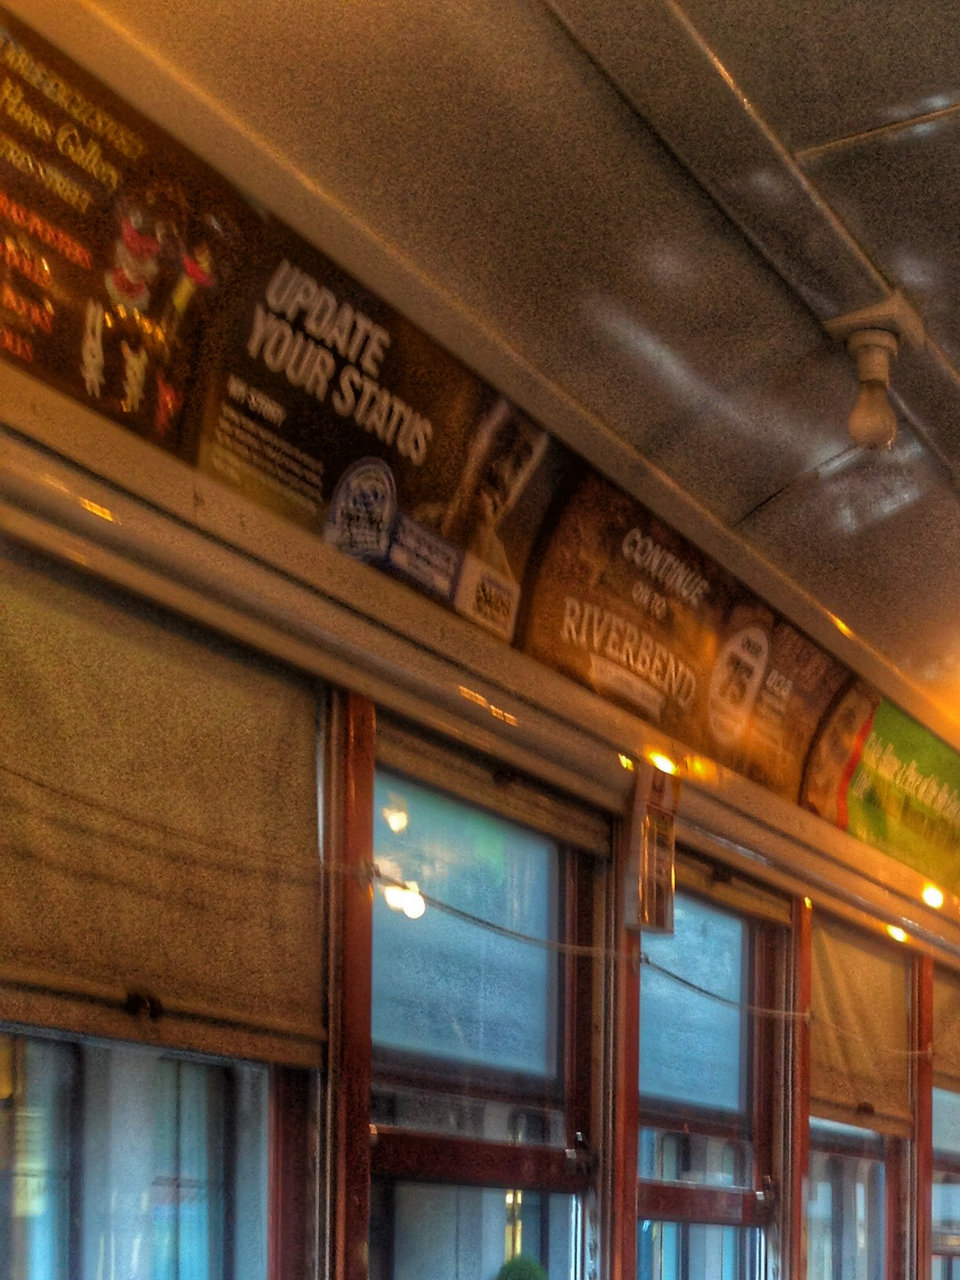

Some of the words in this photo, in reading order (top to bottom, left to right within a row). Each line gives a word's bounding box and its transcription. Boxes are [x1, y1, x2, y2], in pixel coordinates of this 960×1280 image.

[265, 258, 391, 379] UPDATE
[247, 303, 335, 402] YOUR
[331, 365, 434, 466] STATUS
[622, 527, 710, 604] CONTINUE
[561, 596, 696, 707] RIVERBEND
